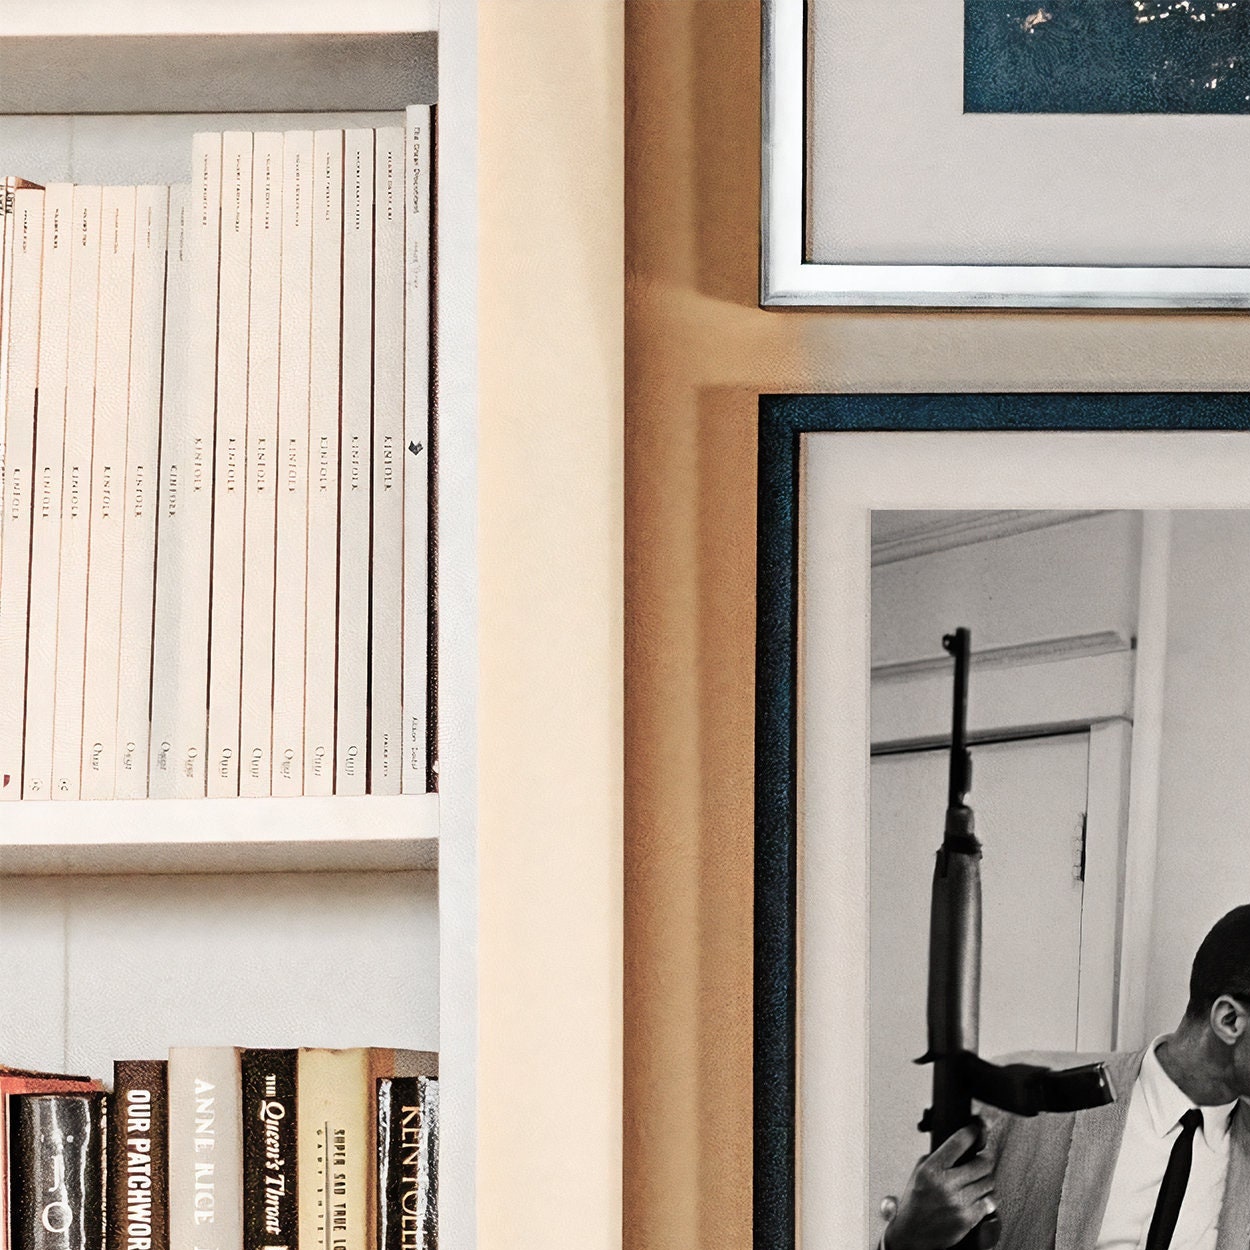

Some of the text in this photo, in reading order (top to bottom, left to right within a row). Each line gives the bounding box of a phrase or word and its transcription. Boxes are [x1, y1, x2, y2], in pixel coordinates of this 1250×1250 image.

[127, 1090, 152, 1132] OUR
[194, 1078, 216, 1224] ANNE RICE
[258, 1100, 285, 1170] Queen's
[333, 1128, 347, 1166] SUPER
[264, 1173, 286, 1236] Throat
[333, 1174, 347, 1196] SAD
[333, 1202, 347, 1231] TRUE
